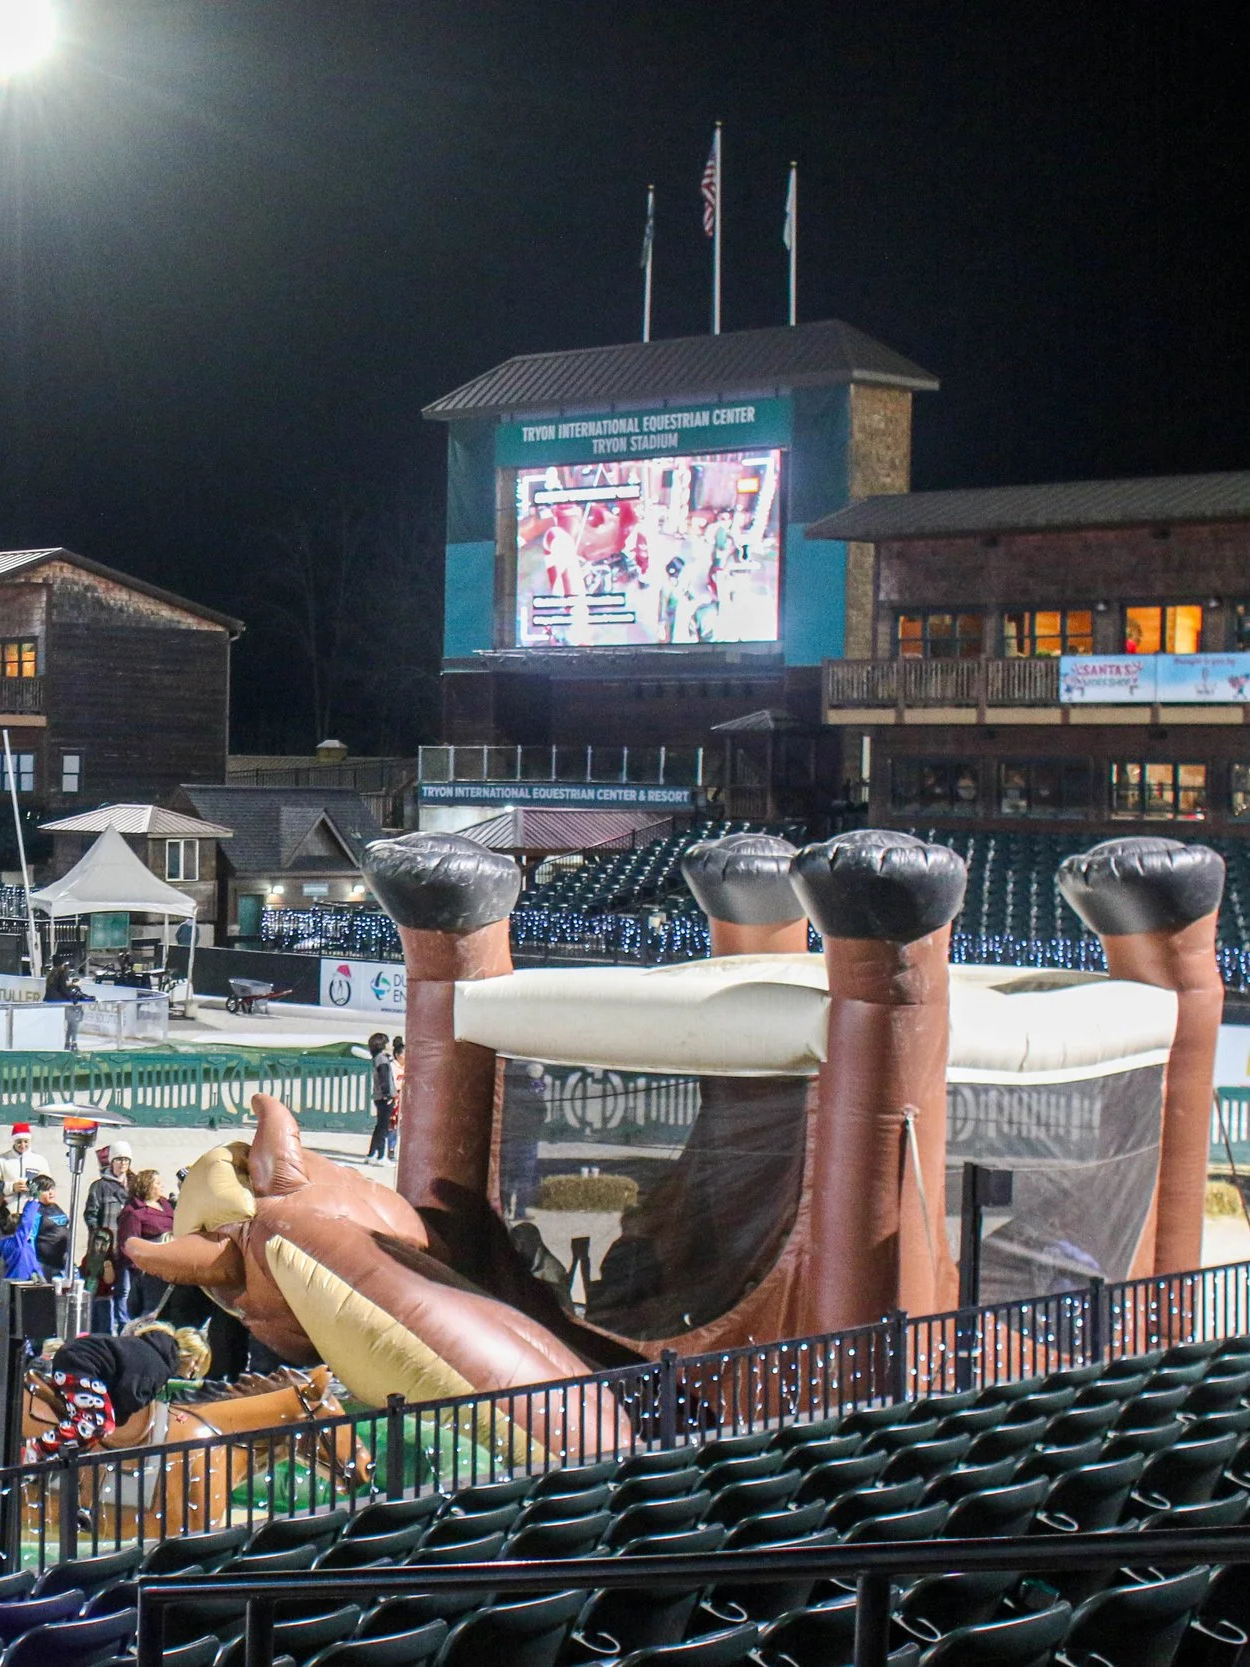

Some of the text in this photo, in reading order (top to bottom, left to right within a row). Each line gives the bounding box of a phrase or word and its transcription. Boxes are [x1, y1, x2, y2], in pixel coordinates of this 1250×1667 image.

[522, 406, 756, 442] TRYON INTERNATIONAL EQUESTRIAN CENTER
[592, 432, 679, 454] TRYON STADIUM
[422, 786, 690, 802] TRYON INTERNATIONAL EQUESTRIAN CENTER & RESORT
